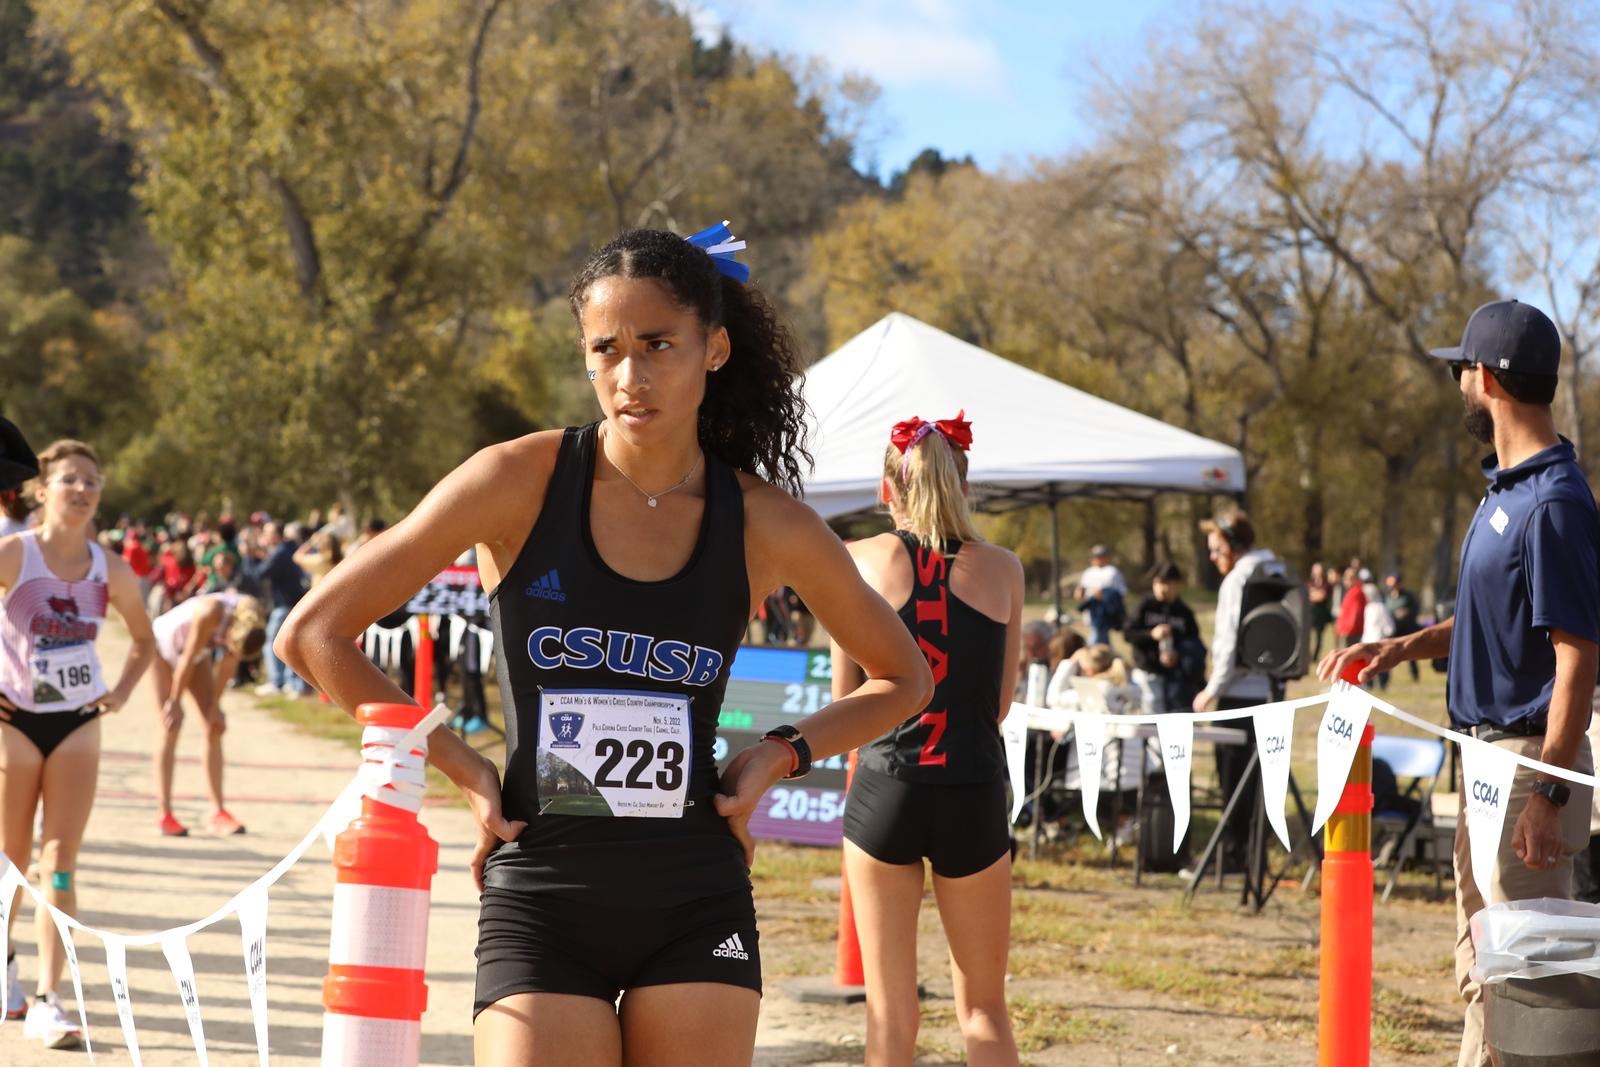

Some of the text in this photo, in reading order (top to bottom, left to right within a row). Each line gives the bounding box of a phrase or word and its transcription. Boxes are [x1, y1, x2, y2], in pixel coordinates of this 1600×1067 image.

[526, 586, 567, 602] adidas
[527, 626, 723, 686] CSUSB
[57, 664, 92, 689] 196
[594, 738, 684, 791] 223
[1472, 779, 1499, 808] CCAA
[712, 947, 749, 961] adidas
